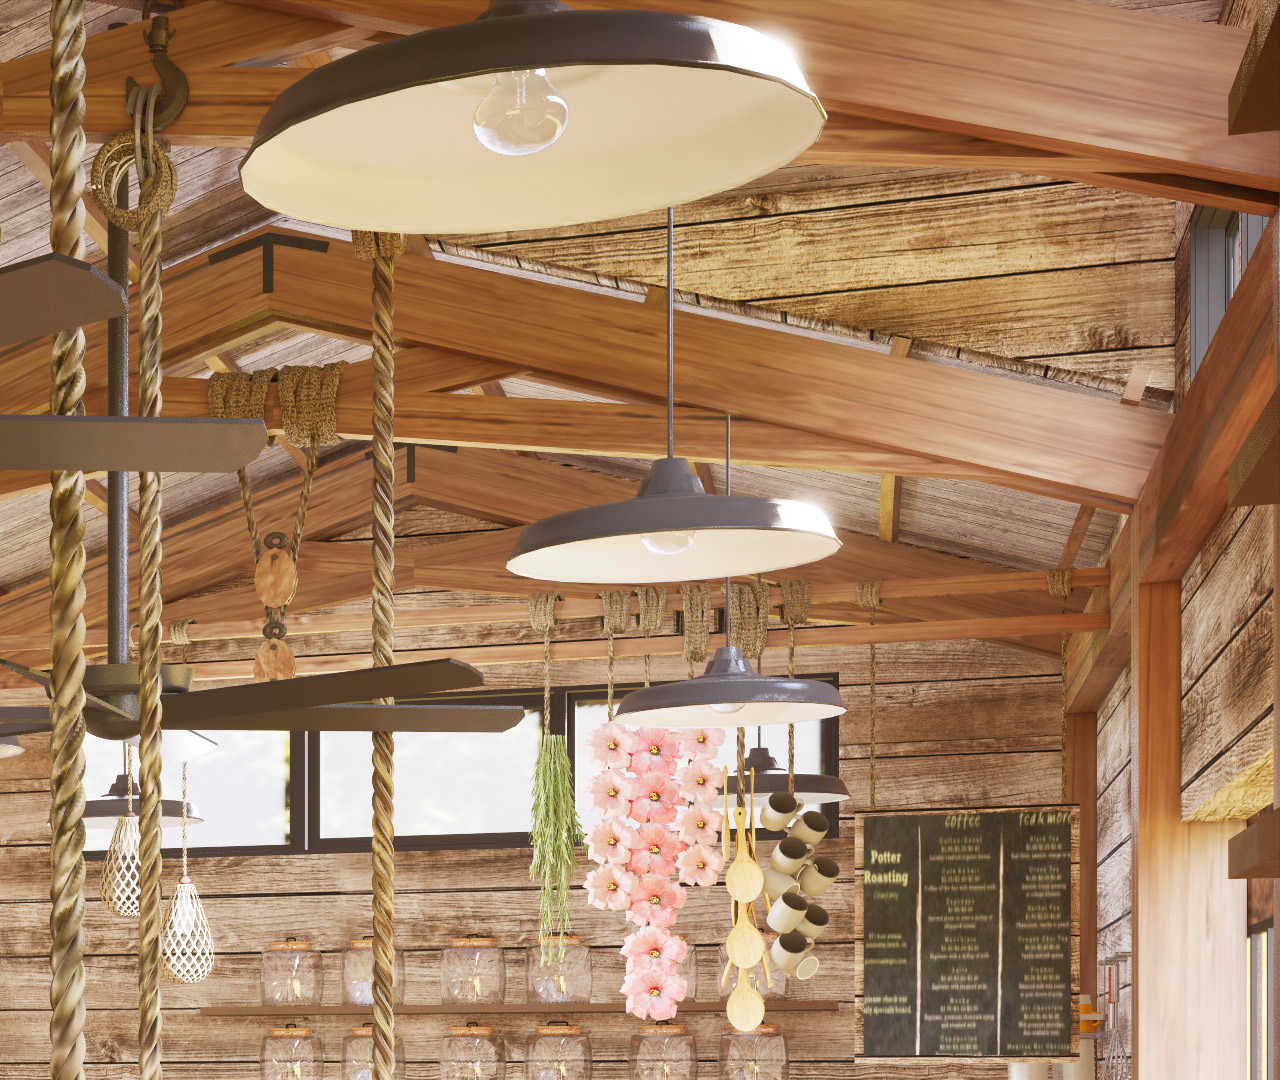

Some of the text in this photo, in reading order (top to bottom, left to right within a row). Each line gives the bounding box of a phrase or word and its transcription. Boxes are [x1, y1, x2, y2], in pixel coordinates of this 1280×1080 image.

[945, 814, 980, 830] coffee
[870, 849, 901, 864] Potter
[864, 869, 908, 887] Roasting
